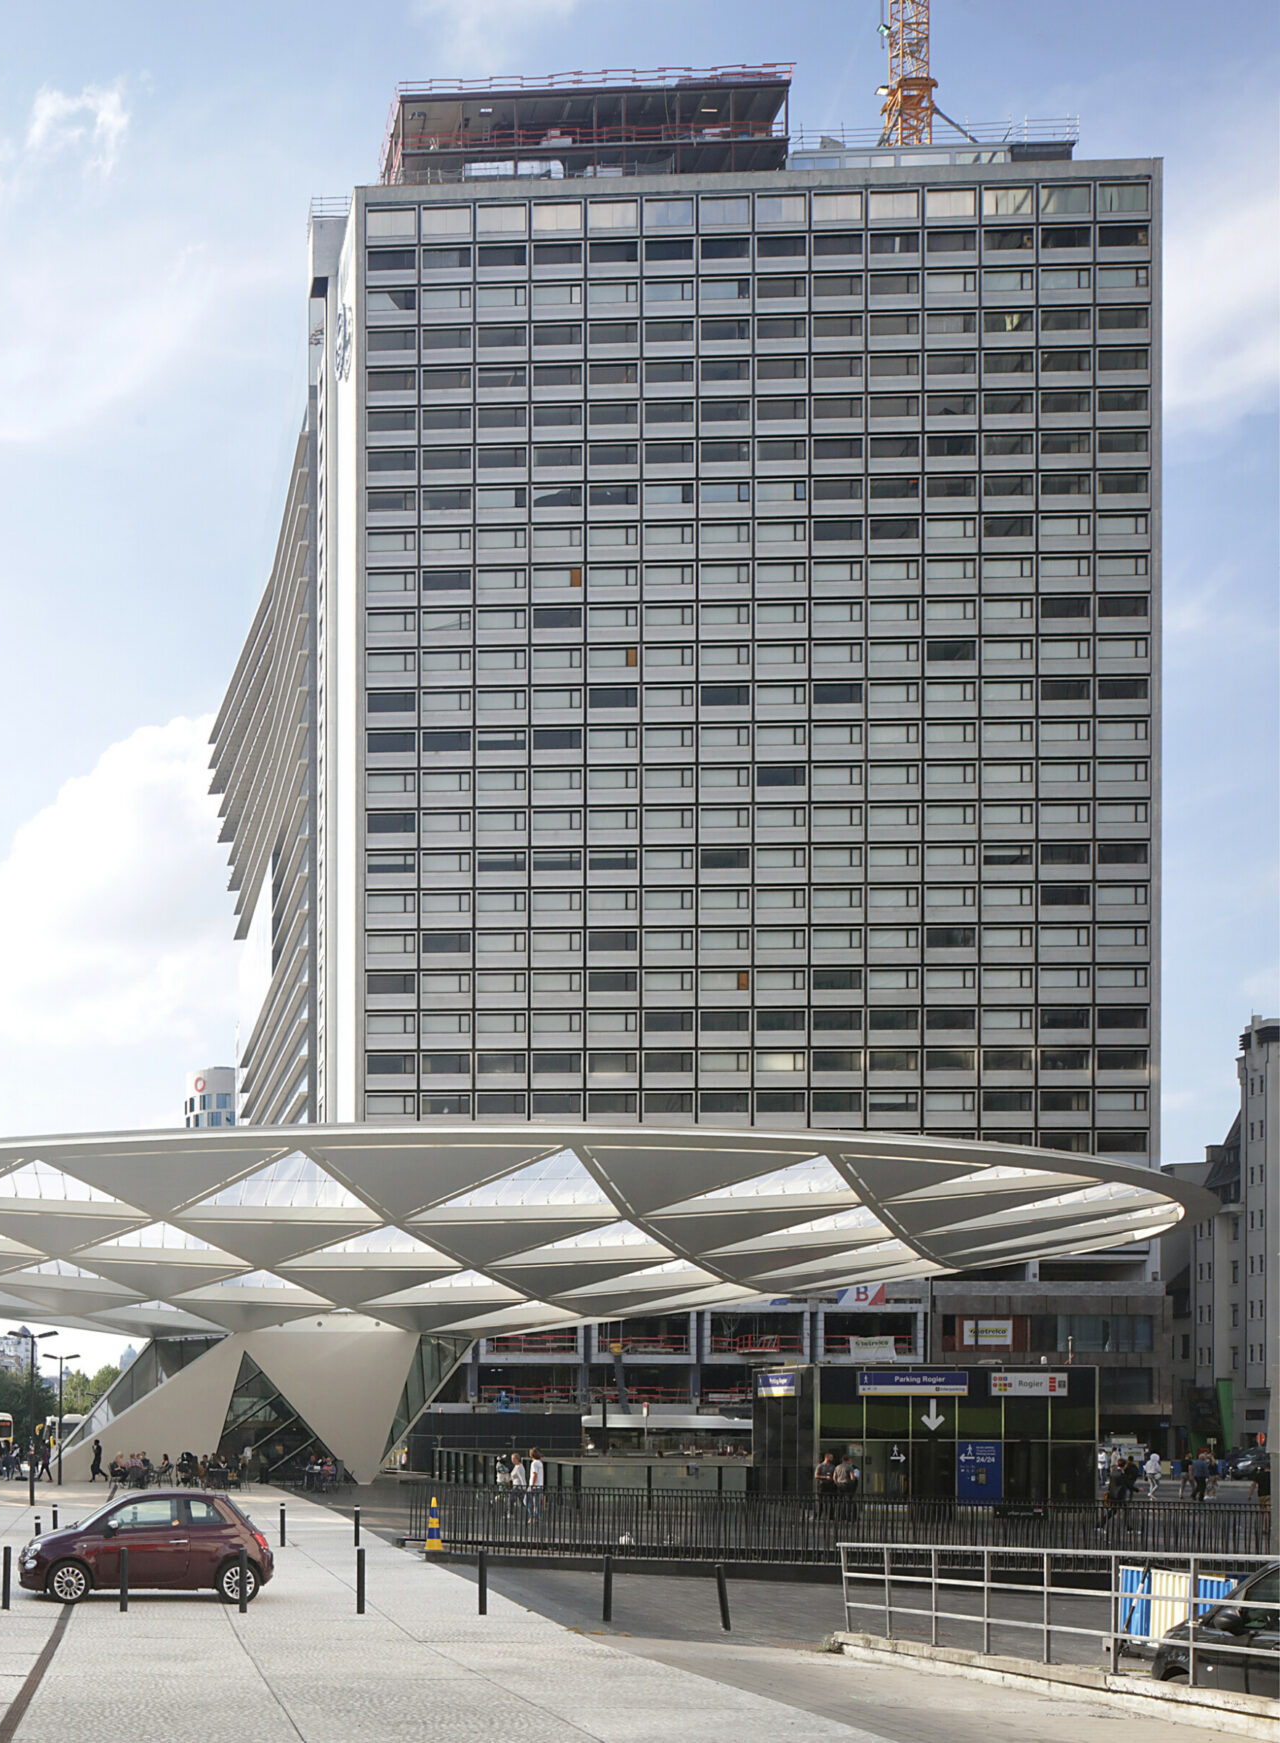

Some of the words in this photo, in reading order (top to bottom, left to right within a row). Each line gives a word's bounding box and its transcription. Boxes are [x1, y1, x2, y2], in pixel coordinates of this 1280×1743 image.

[894, 1375, 921, 1384] Parking
[922, 1375, 946, 1384] Rogier
[1018, 1379, 1044, 1388] Rogier
